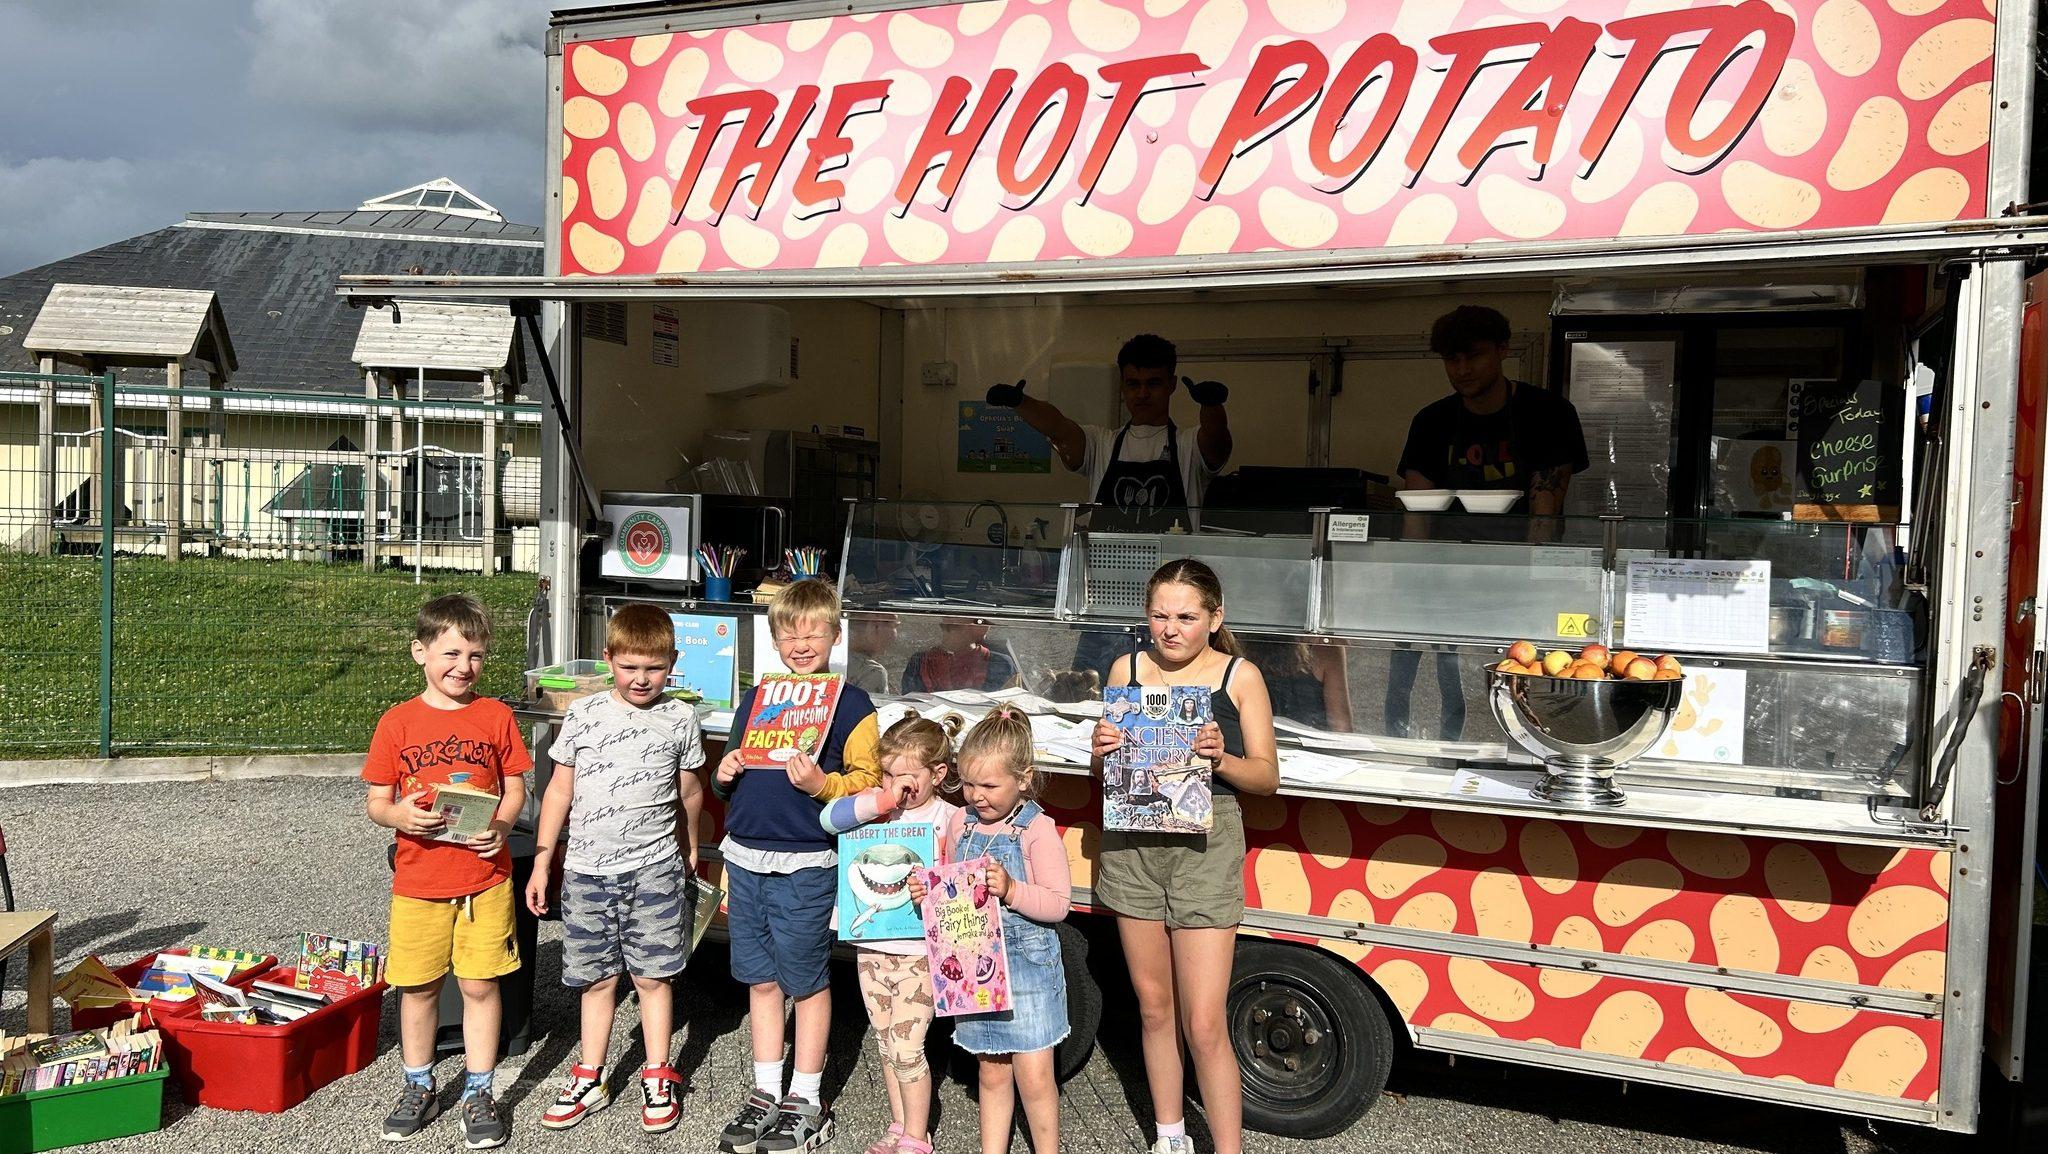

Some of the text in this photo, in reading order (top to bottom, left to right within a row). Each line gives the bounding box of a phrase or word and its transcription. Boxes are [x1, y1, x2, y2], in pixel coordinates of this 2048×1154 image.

[669, 0, 1798, 227] THE HOT POTATO
[1829, 407, 1885, 424] Today
[1810, 433, 1875, 460] Cheese
[1810, 455, 1887, 489] Surprise
[620, 513, 671, 553] COMMUNITY CAMPAIGNS
[1332, 520, 1365, 528] Allergens
[685, 635, 708, 646] Book
[762, 680, 828, 706] 1001
[1145, 693, 1167, 706] 1000
[781, 705, 829, 732] gruesome
[744, 729, 796, 750] FACTS
[1119, 747, 1190, 764] HISTORY
[845, 826, 928, 840] GILBERT THE GREAT
[934, 905, 946, 919] Big
[946, 903, 964, 917] Book
[939, 918, 962, 934] Fairy
[963, 912, 989, 930] things
